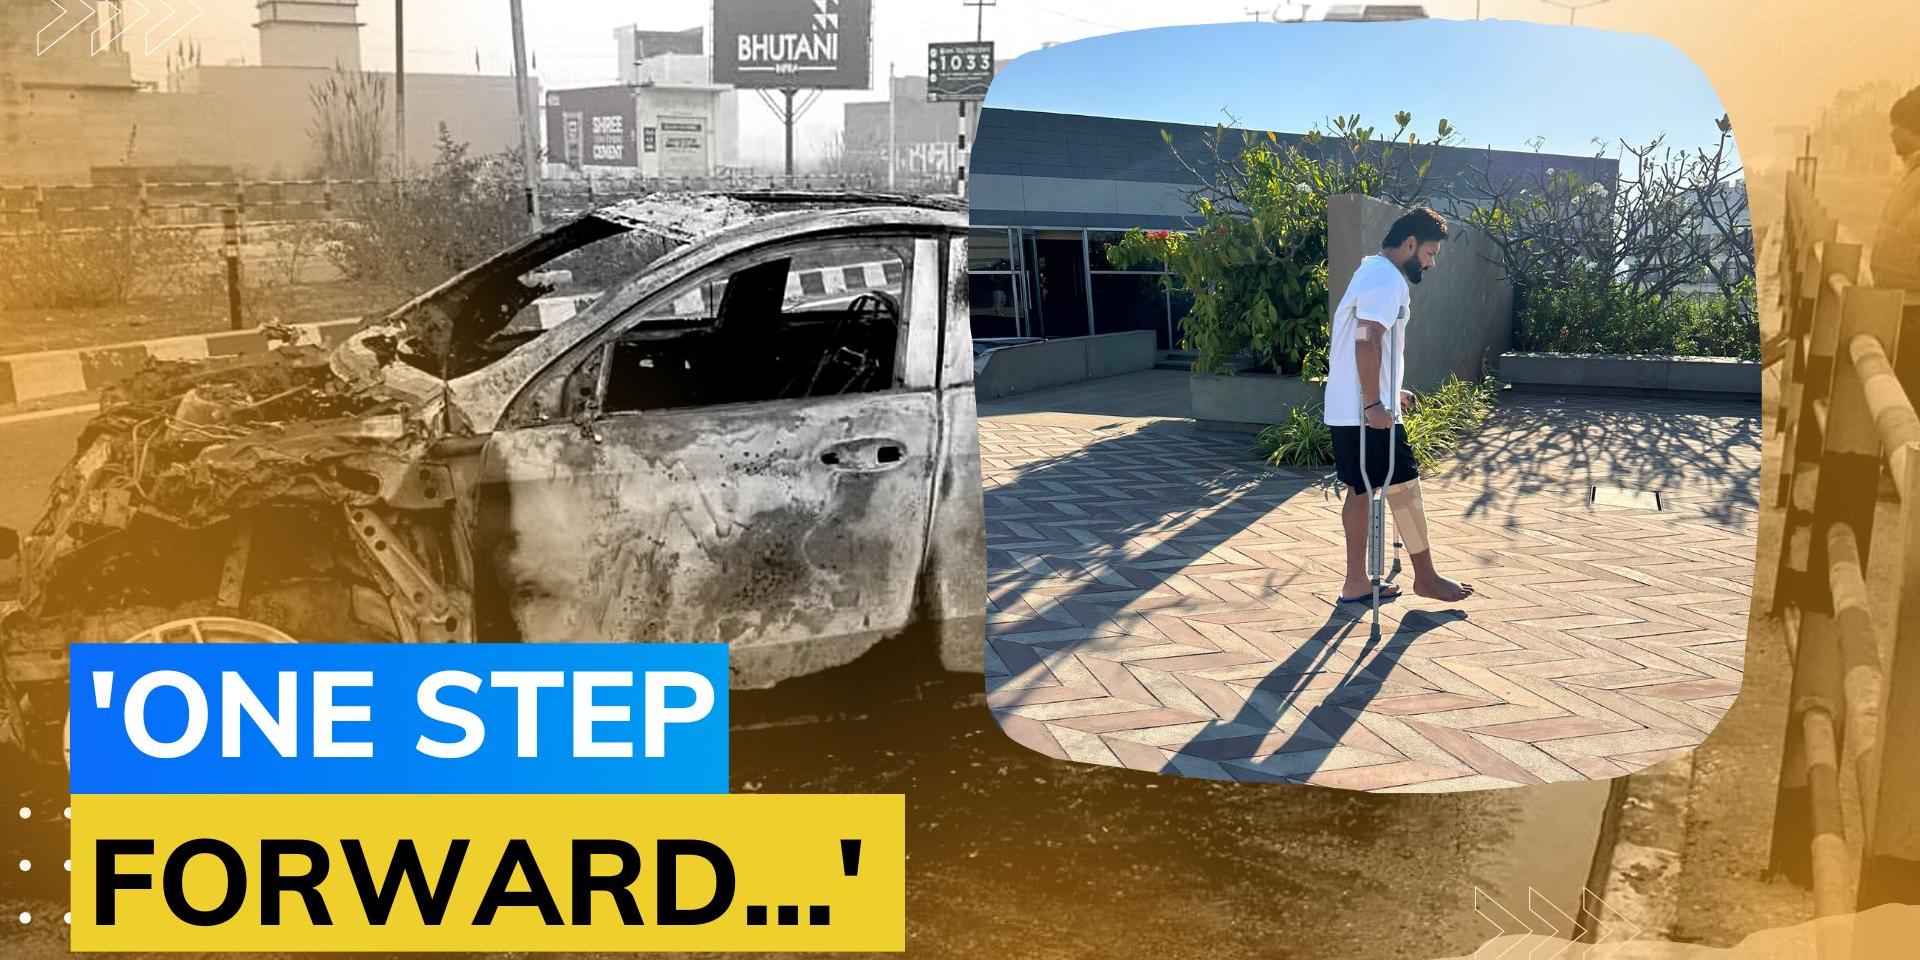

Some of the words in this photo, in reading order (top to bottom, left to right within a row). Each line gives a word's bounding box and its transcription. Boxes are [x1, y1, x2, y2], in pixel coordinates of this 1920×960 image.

[738, 33, 838, 61] BHUTANI
[940, 55, 990, 71] 1033
[592, 115, 623, 133] SHREE
[593, 145, 623, 160] CEMENT
